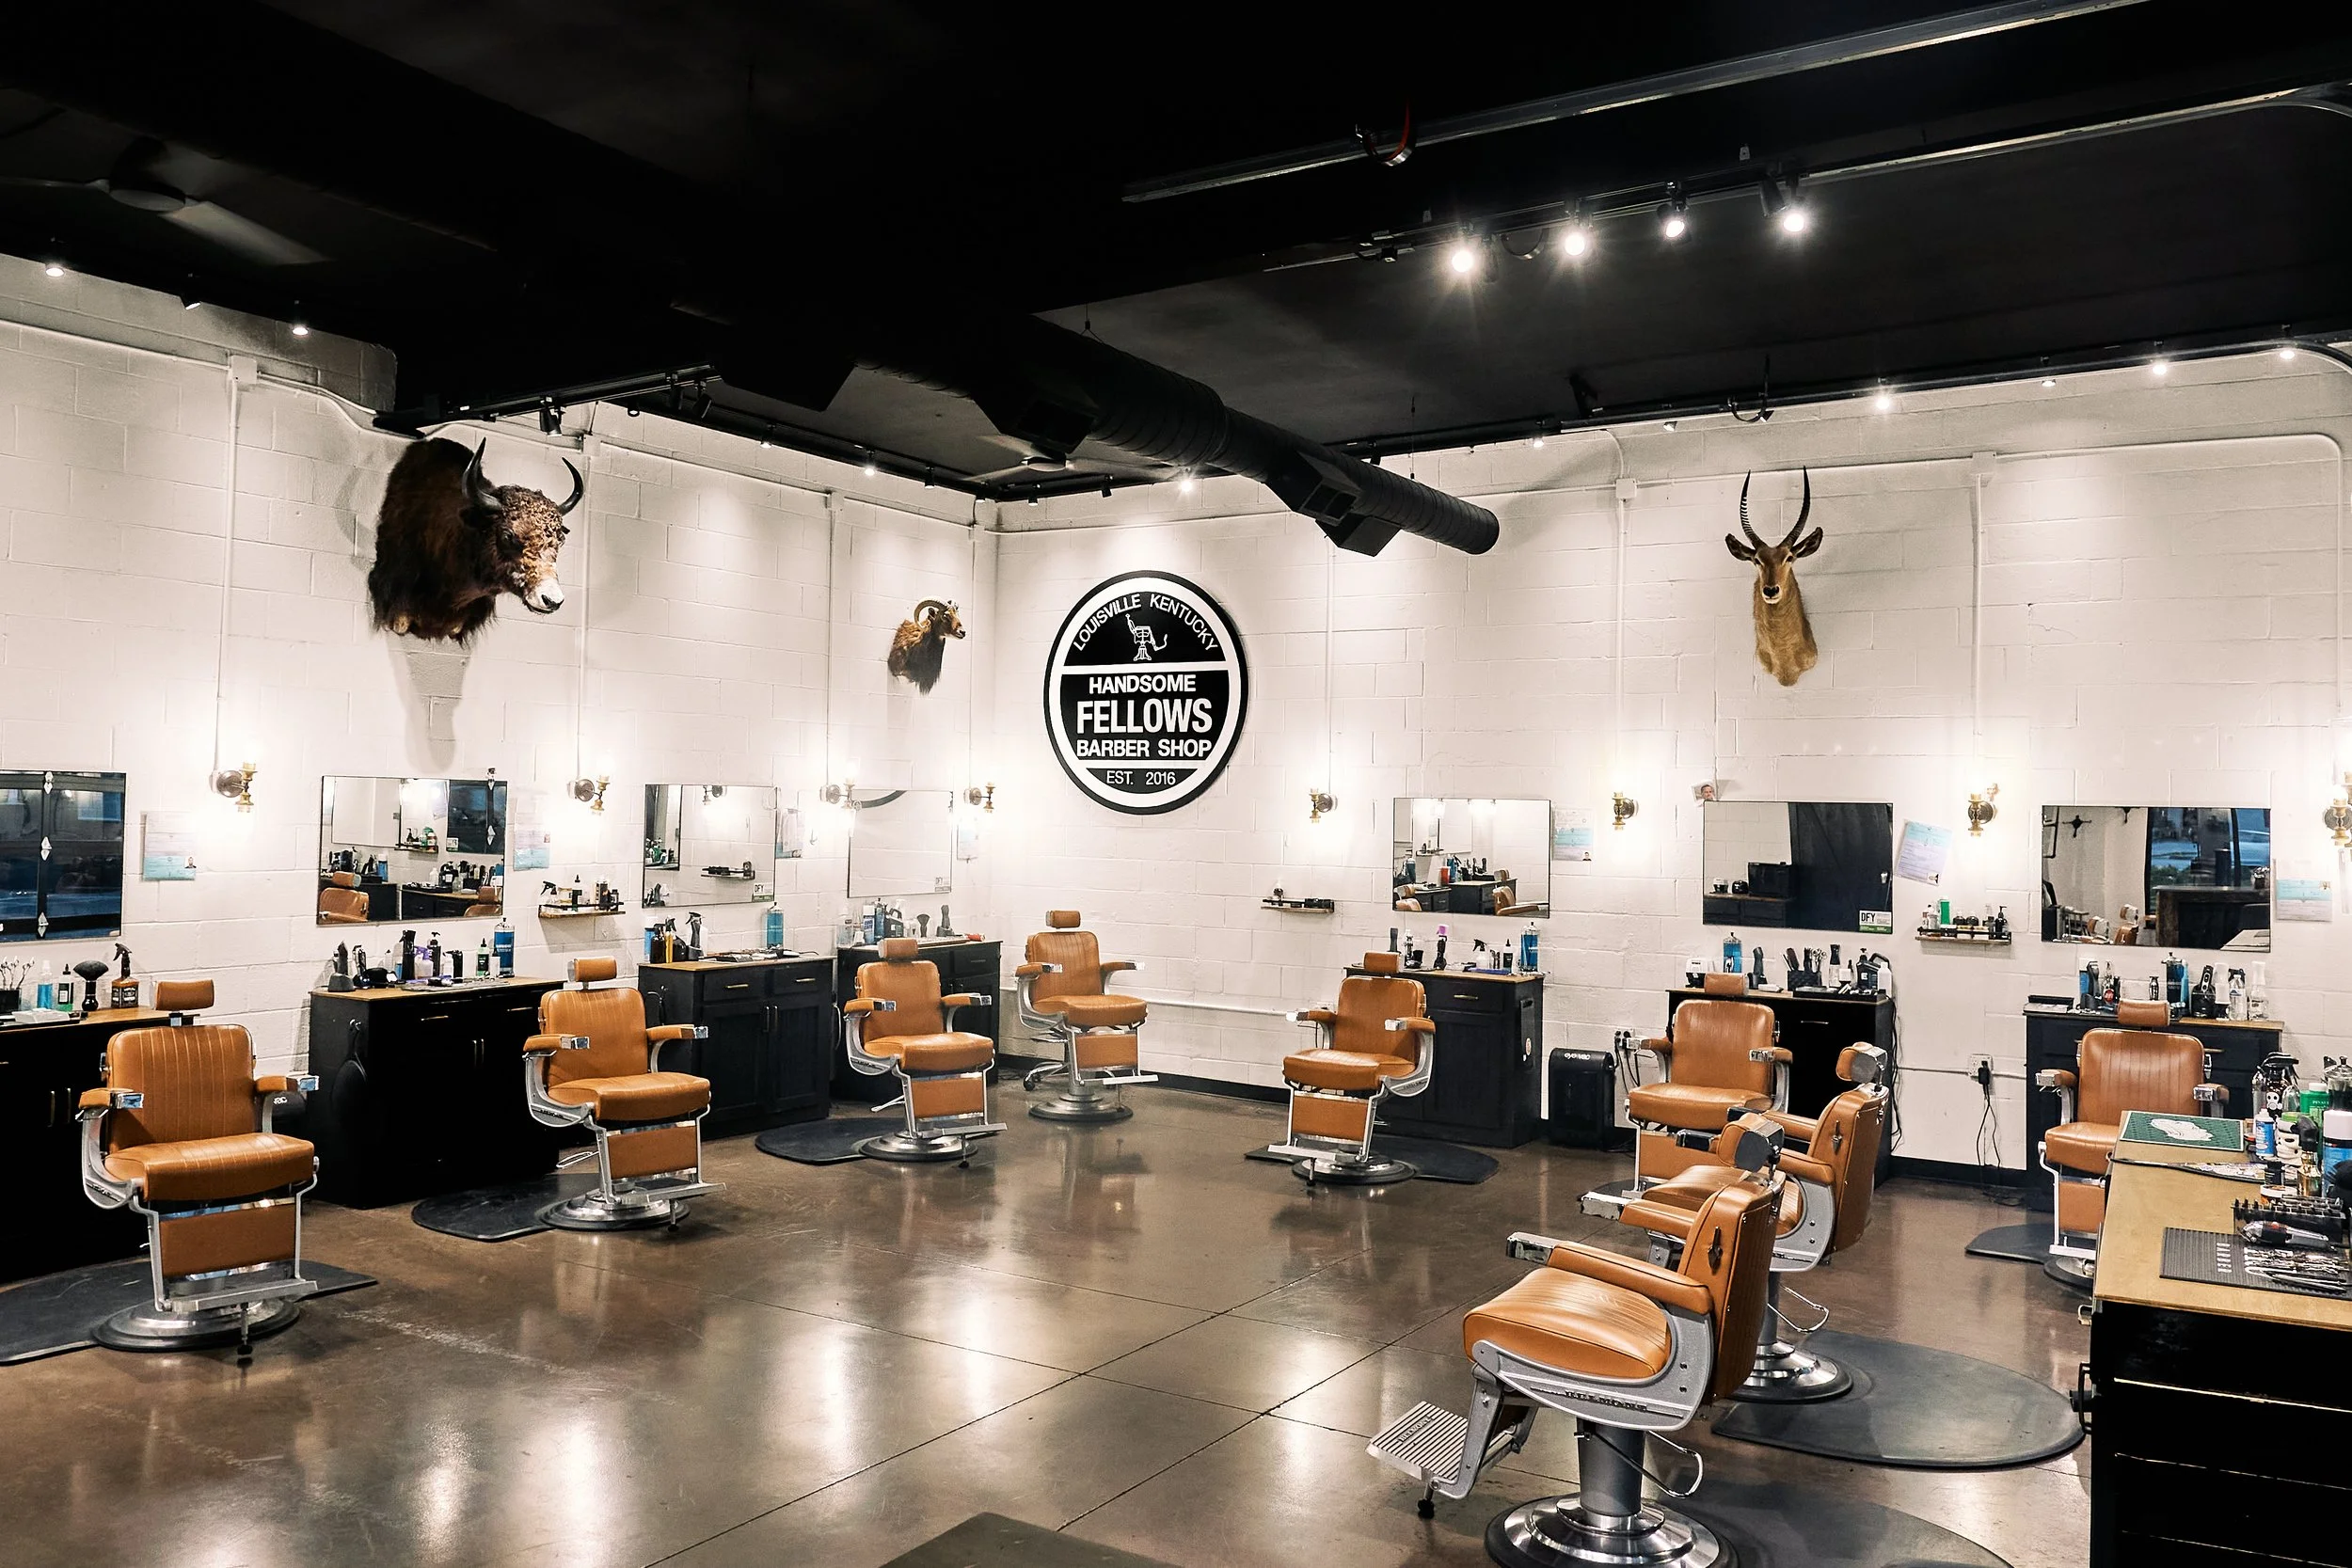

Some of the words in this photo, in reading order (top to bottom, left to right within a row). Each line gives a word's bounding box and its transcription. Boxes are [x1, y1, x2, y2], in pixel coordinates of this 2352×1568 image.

[1073, 594, 1142, 651] LOUISVILLE
[1150, 594, 1218, 652] KENTUCKY
[1089, 673, 1196, 694] HANDSOME
[1076, 698, 1213, 734] FELLOWS
[1076, 739, 1150, 757] BARBER
[1157, 738, 1212, 757] SHOP
[1106, 770, 1134, 784] EST.
[1145, 771, 1176, 785] 2016
[1861, 912, 1875, 922] DFY
